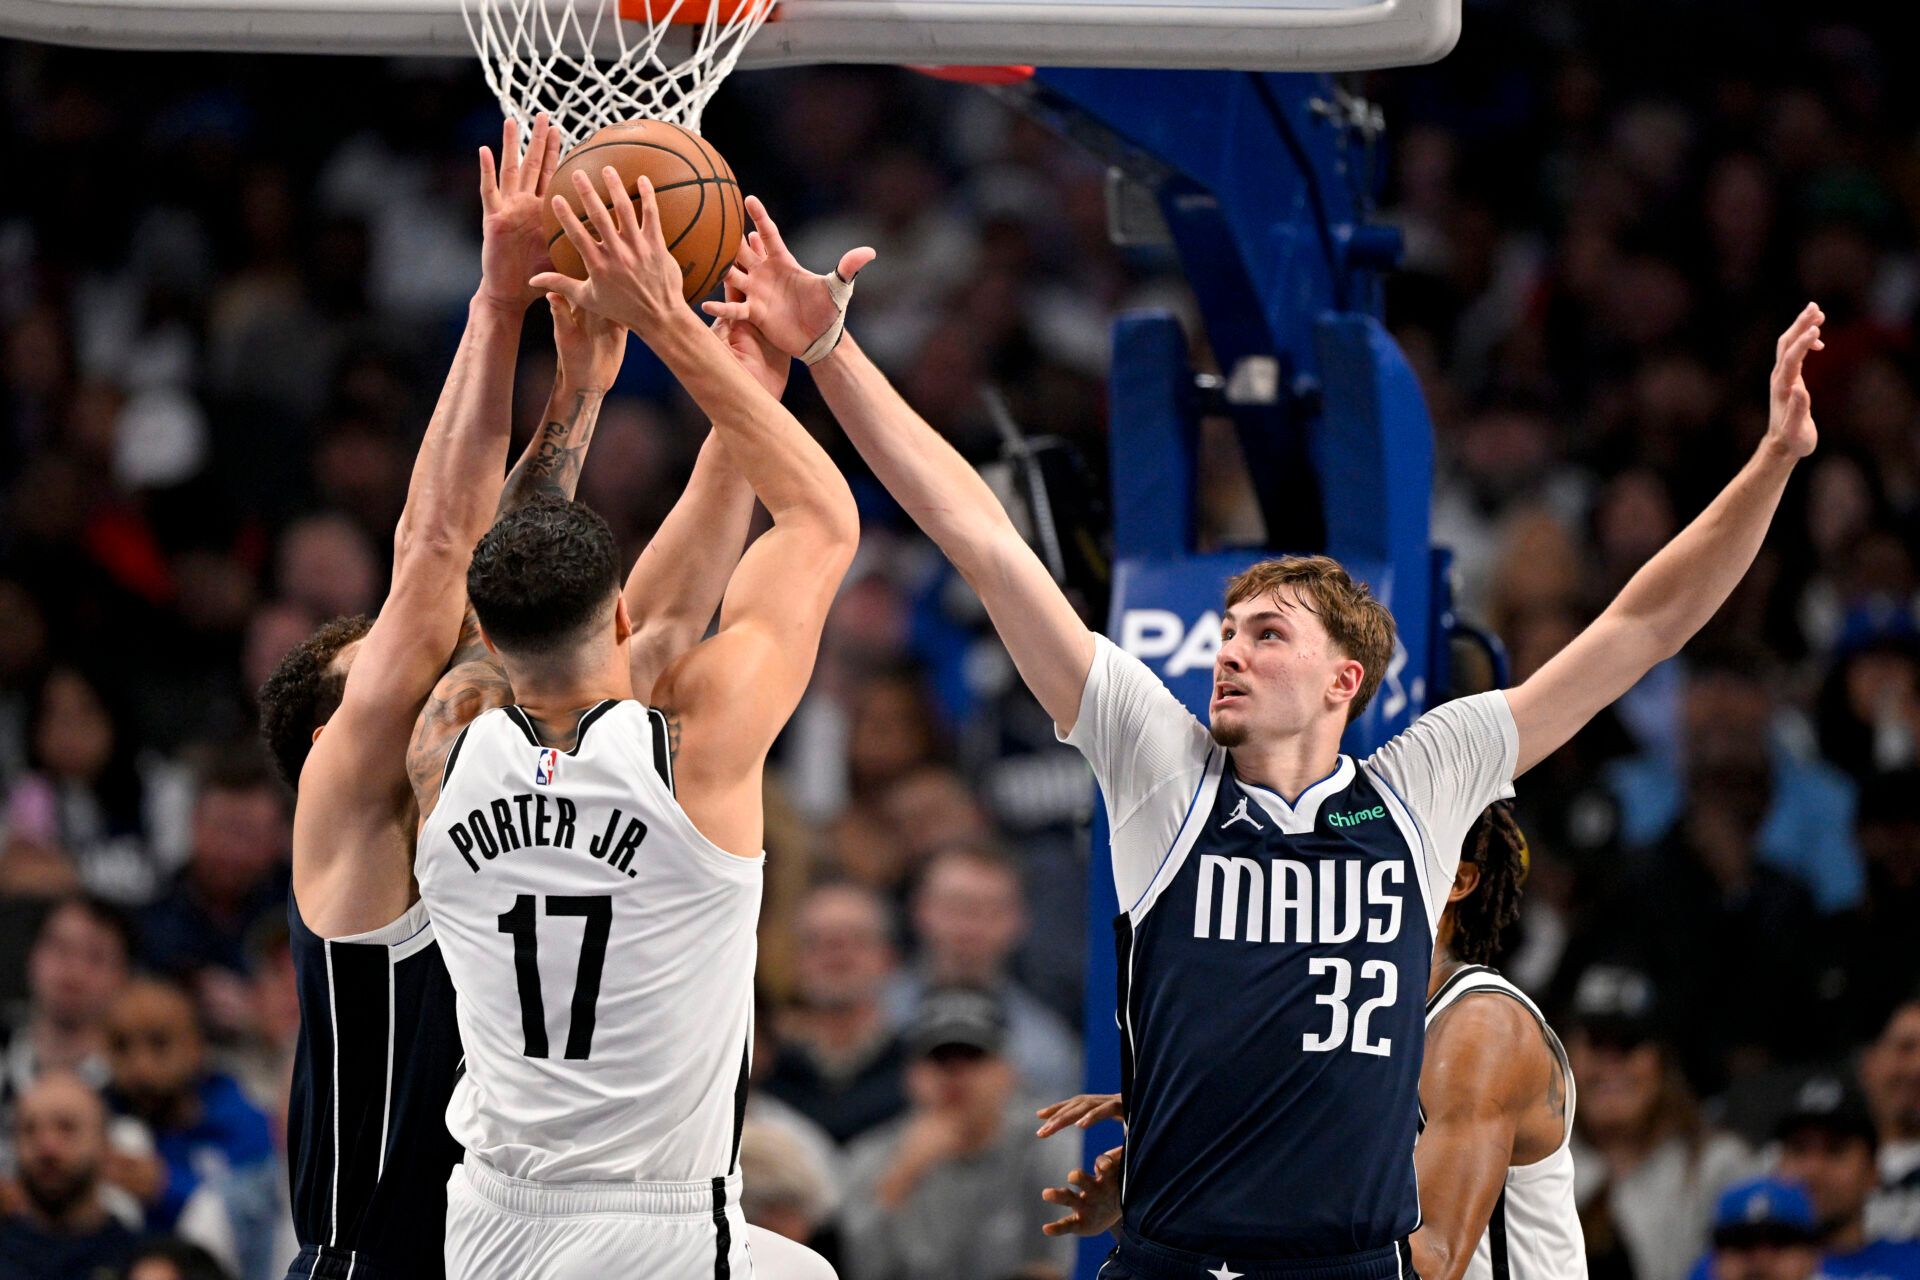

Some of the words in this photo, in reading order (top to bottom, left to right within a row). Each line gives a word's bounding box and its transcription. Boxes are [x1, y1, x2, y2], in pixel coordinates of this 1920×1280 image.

[1121, 609, 1221, 677] PA
[448, 794, 577, 874] PORTER
[589, 808, 648, 878] JR.
[1193, 854, 1405, 943] MAVS
[498, 894, 612, 1060] 17
[1302, 957, 1398, 1057] 32
